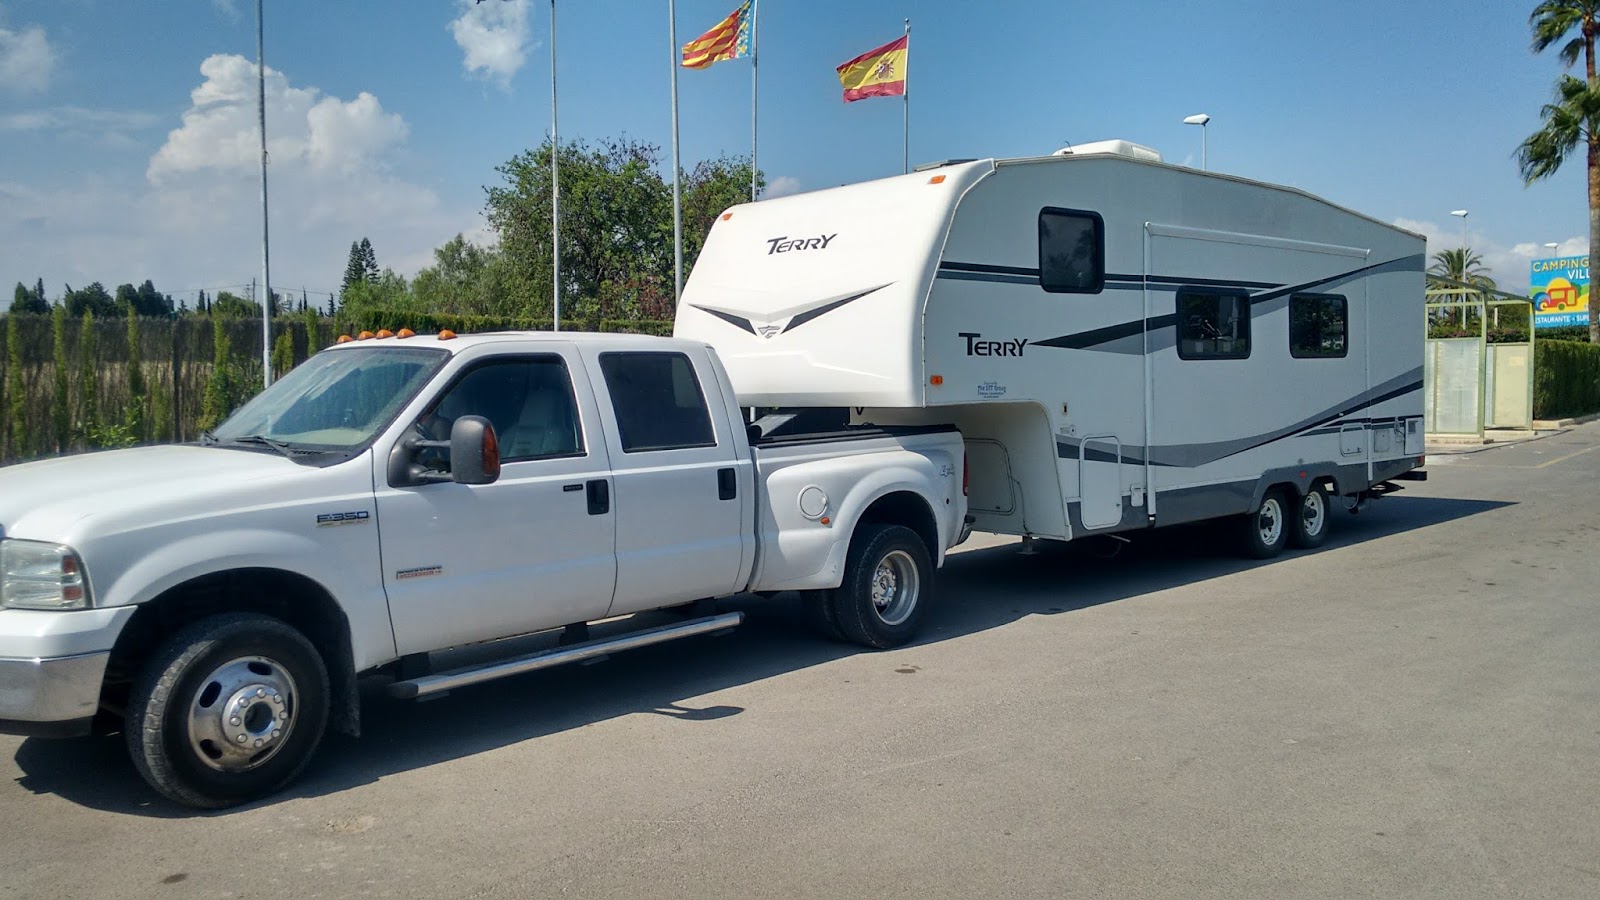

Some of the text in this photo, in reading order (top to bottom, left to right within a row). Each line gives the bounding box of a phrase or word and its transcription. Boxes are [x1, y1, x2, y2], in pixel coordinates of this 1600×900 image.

[767, 233, 838, 255] TERRY
[1533, 258, 1589, 272] CAMPING
[1535, 315, 1571, 324] ESTAURANTE
[958, 333, 1028, 357] TERRY
